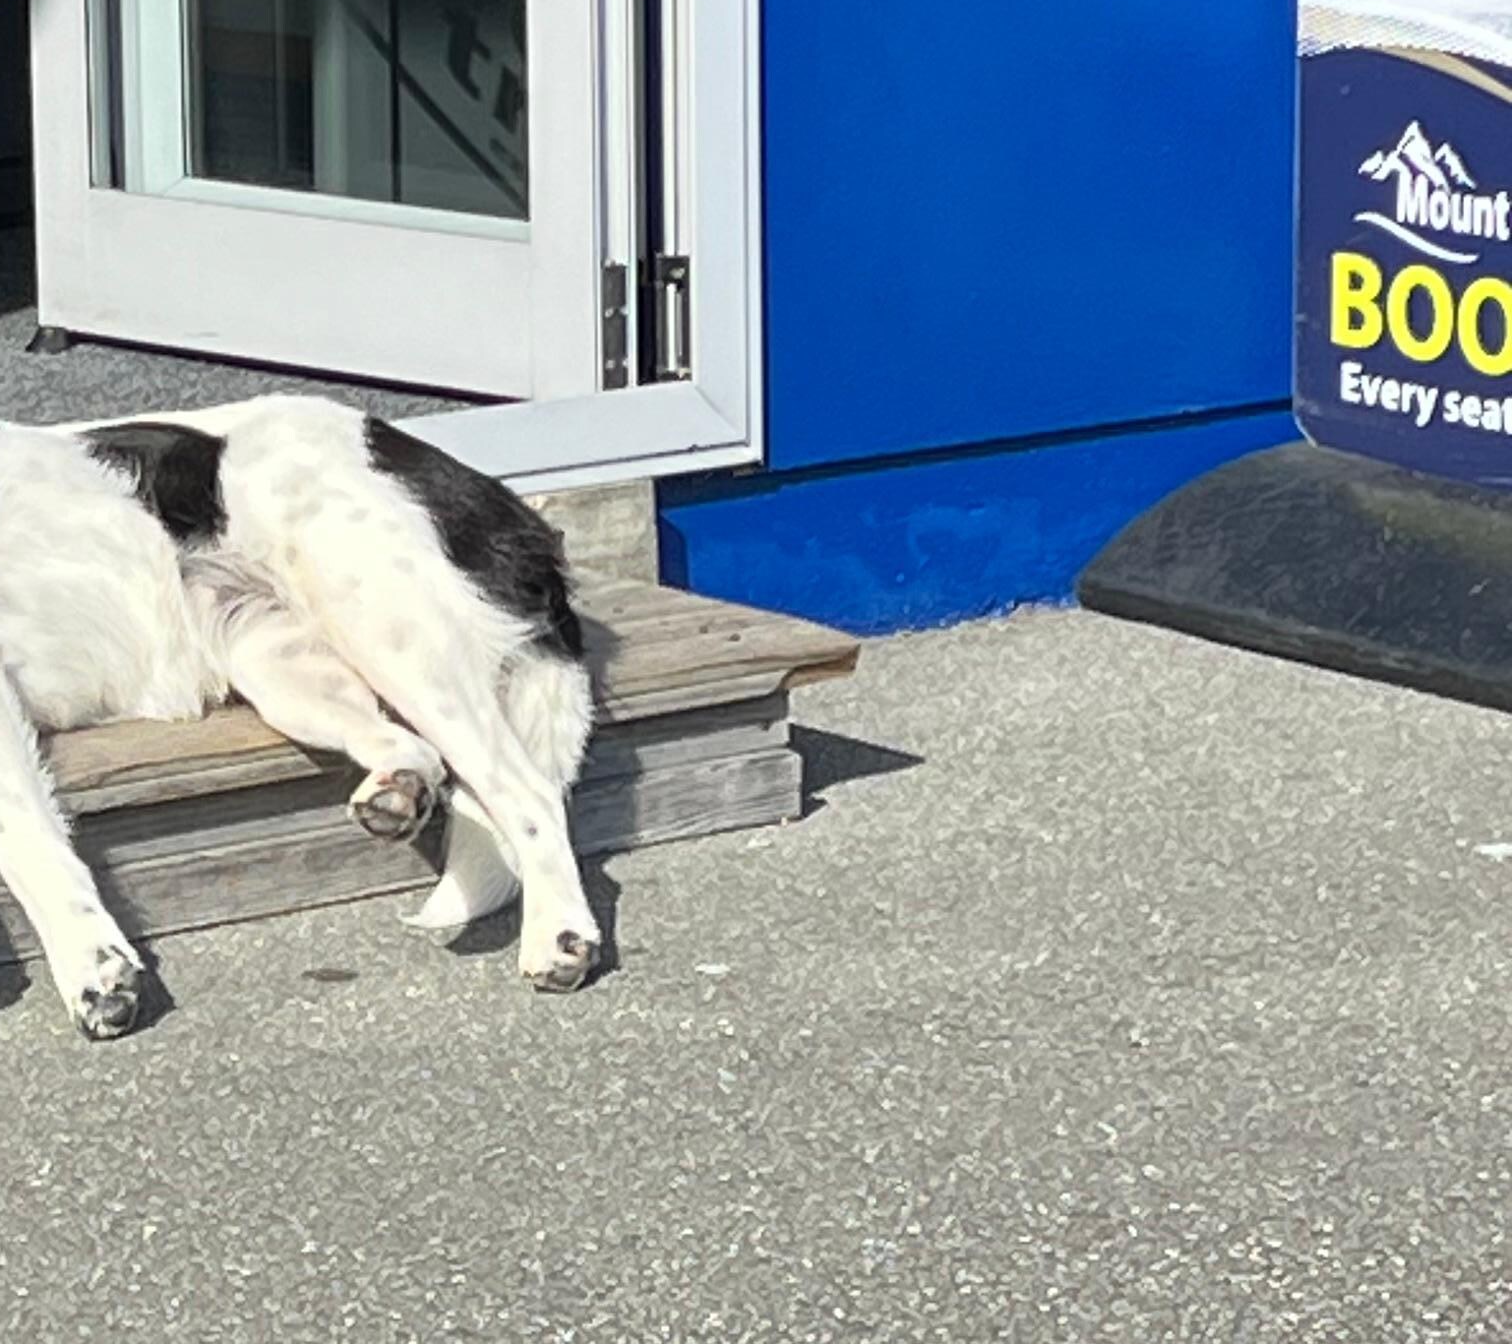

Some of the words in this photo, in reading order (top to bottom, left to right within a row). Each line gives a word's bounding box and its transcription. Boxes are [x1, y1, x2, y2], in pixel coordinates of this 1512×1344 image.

[1395, 172, 1511, 242] Mount
[1329, 251, 1512, 376] BOO
[1339, 360, 1439, 428] Every
